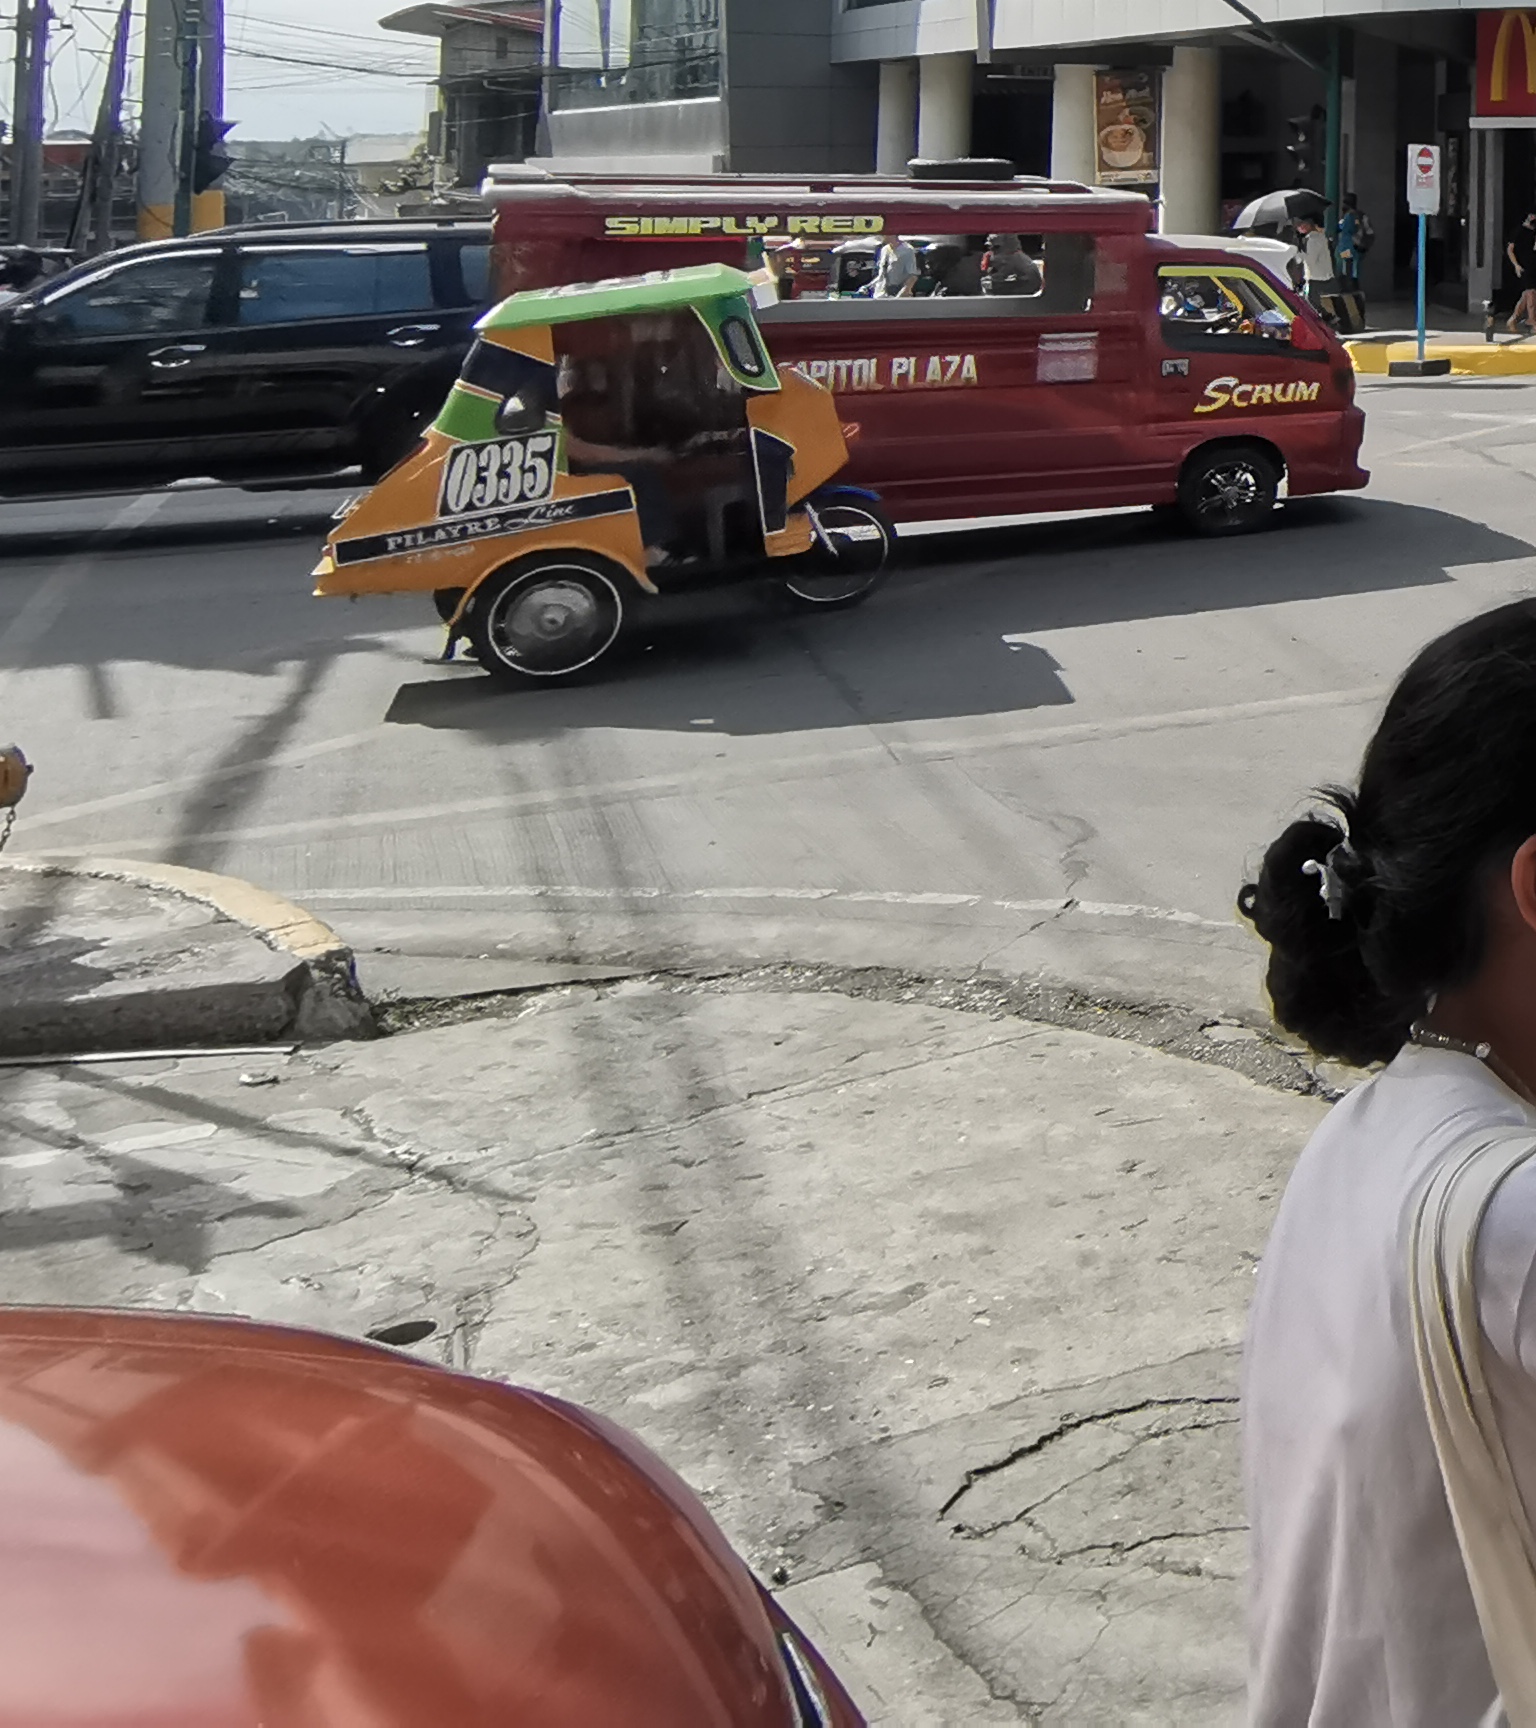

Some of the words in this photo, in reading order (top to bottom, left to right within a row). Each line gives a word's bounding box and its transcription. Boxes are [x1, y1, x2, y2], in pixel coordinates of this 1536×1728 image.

[604, 216, 779, 235] SIMPLY
[787, 215, 885, 234] RED
[891, 354, 978, 387] PLAZA
[447, 436, 553, 512] 0335
[386, 518, 500, 551] PILAYRE
